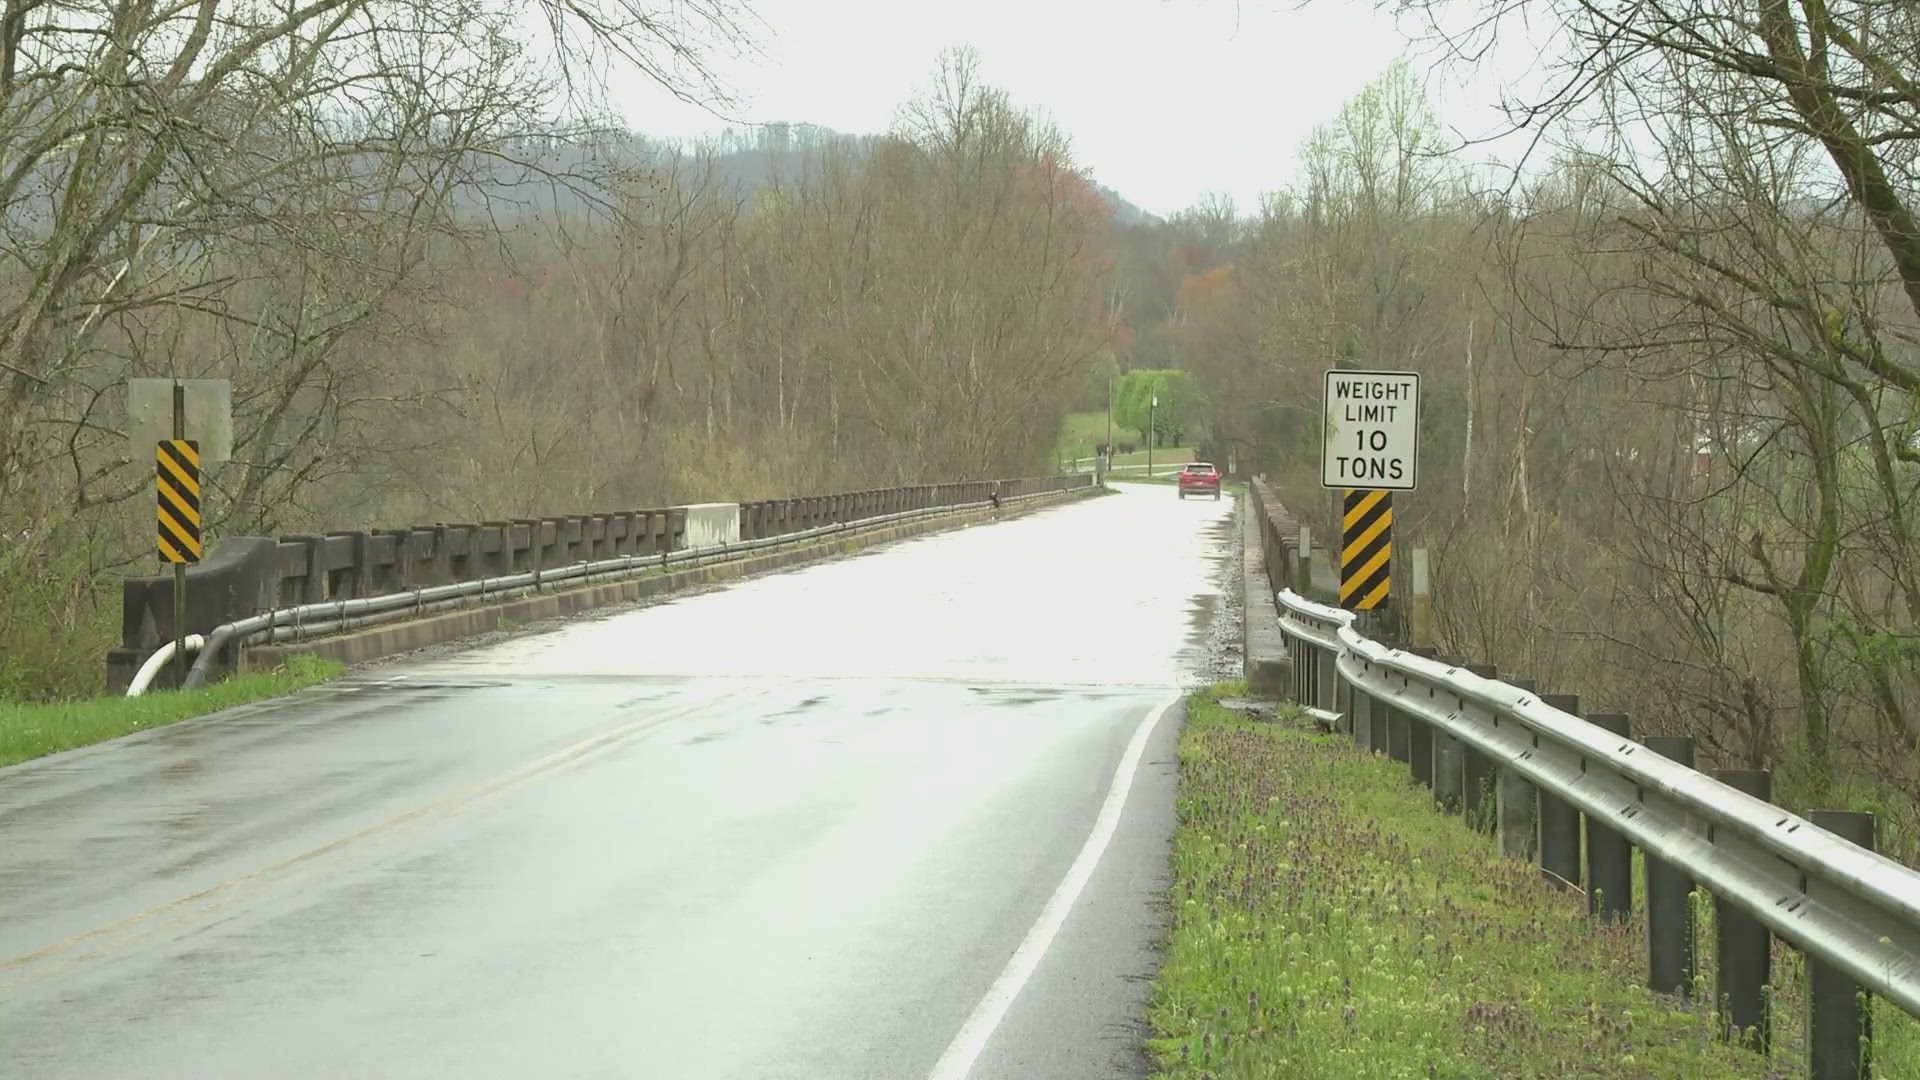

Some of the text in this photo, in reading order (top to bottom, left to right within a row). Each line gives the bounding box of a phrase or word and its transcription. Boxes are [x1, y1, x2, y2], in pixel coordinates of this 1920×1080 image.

[1336, 381, 1411, 401] WEIGHT
[1345, 404, 1397, 423] LIMIT
[1356, 429, 1387, 452] 10
[1336, 456, 1403, 480] TONS
